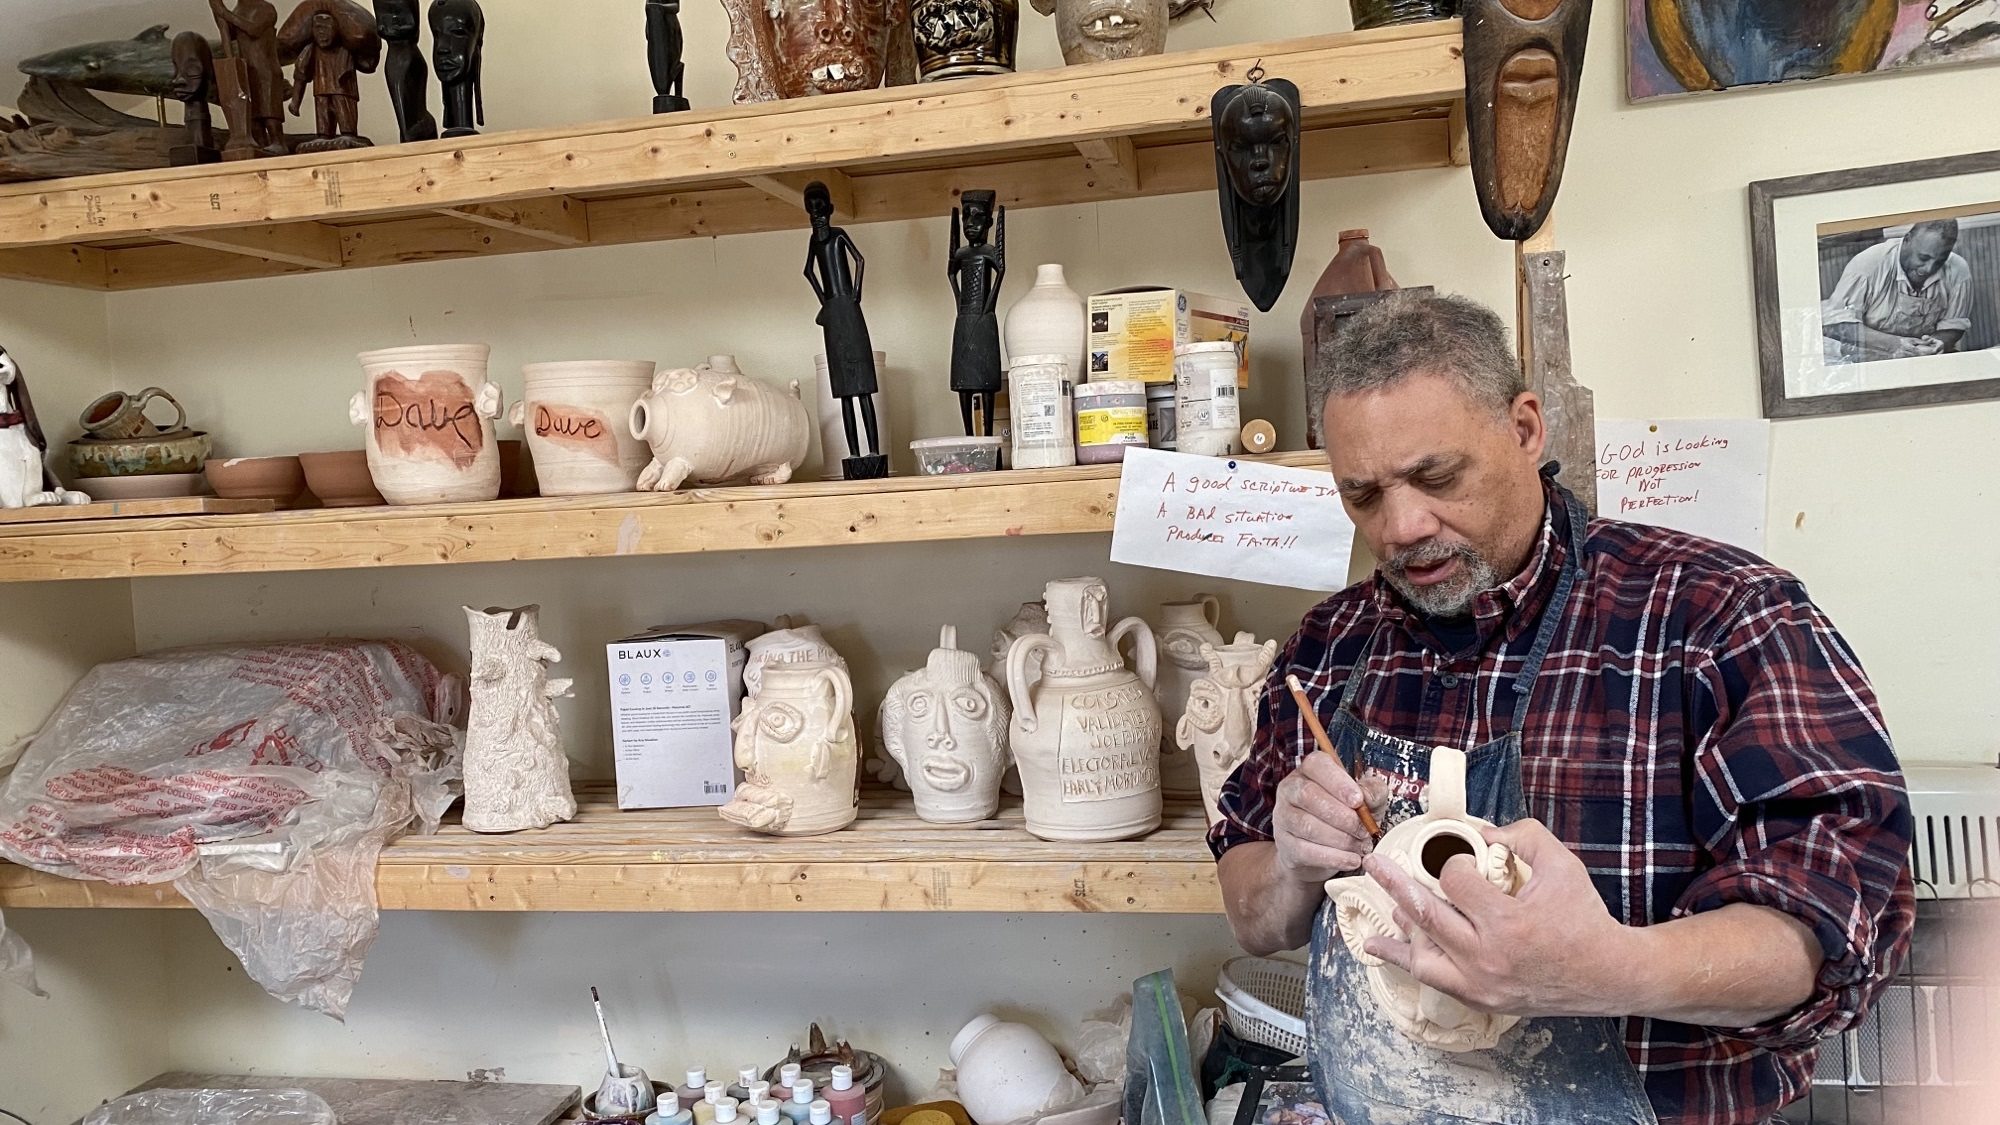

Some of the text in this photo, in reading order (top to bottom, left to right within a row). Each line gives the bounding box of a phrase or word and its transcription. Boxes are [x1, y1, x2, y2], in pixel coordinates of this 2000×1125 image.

[1656, 441, 1669, 456] is
[1162, 471, 1175, 493] A
[1185, 475, 1233, 494] good
[1157, 501, 1168, 519] A
[618, 648, 662, 660] BLAUX
[789, 648, 814, 663] THE
[1062, 778, 1104, 796] EARLY
